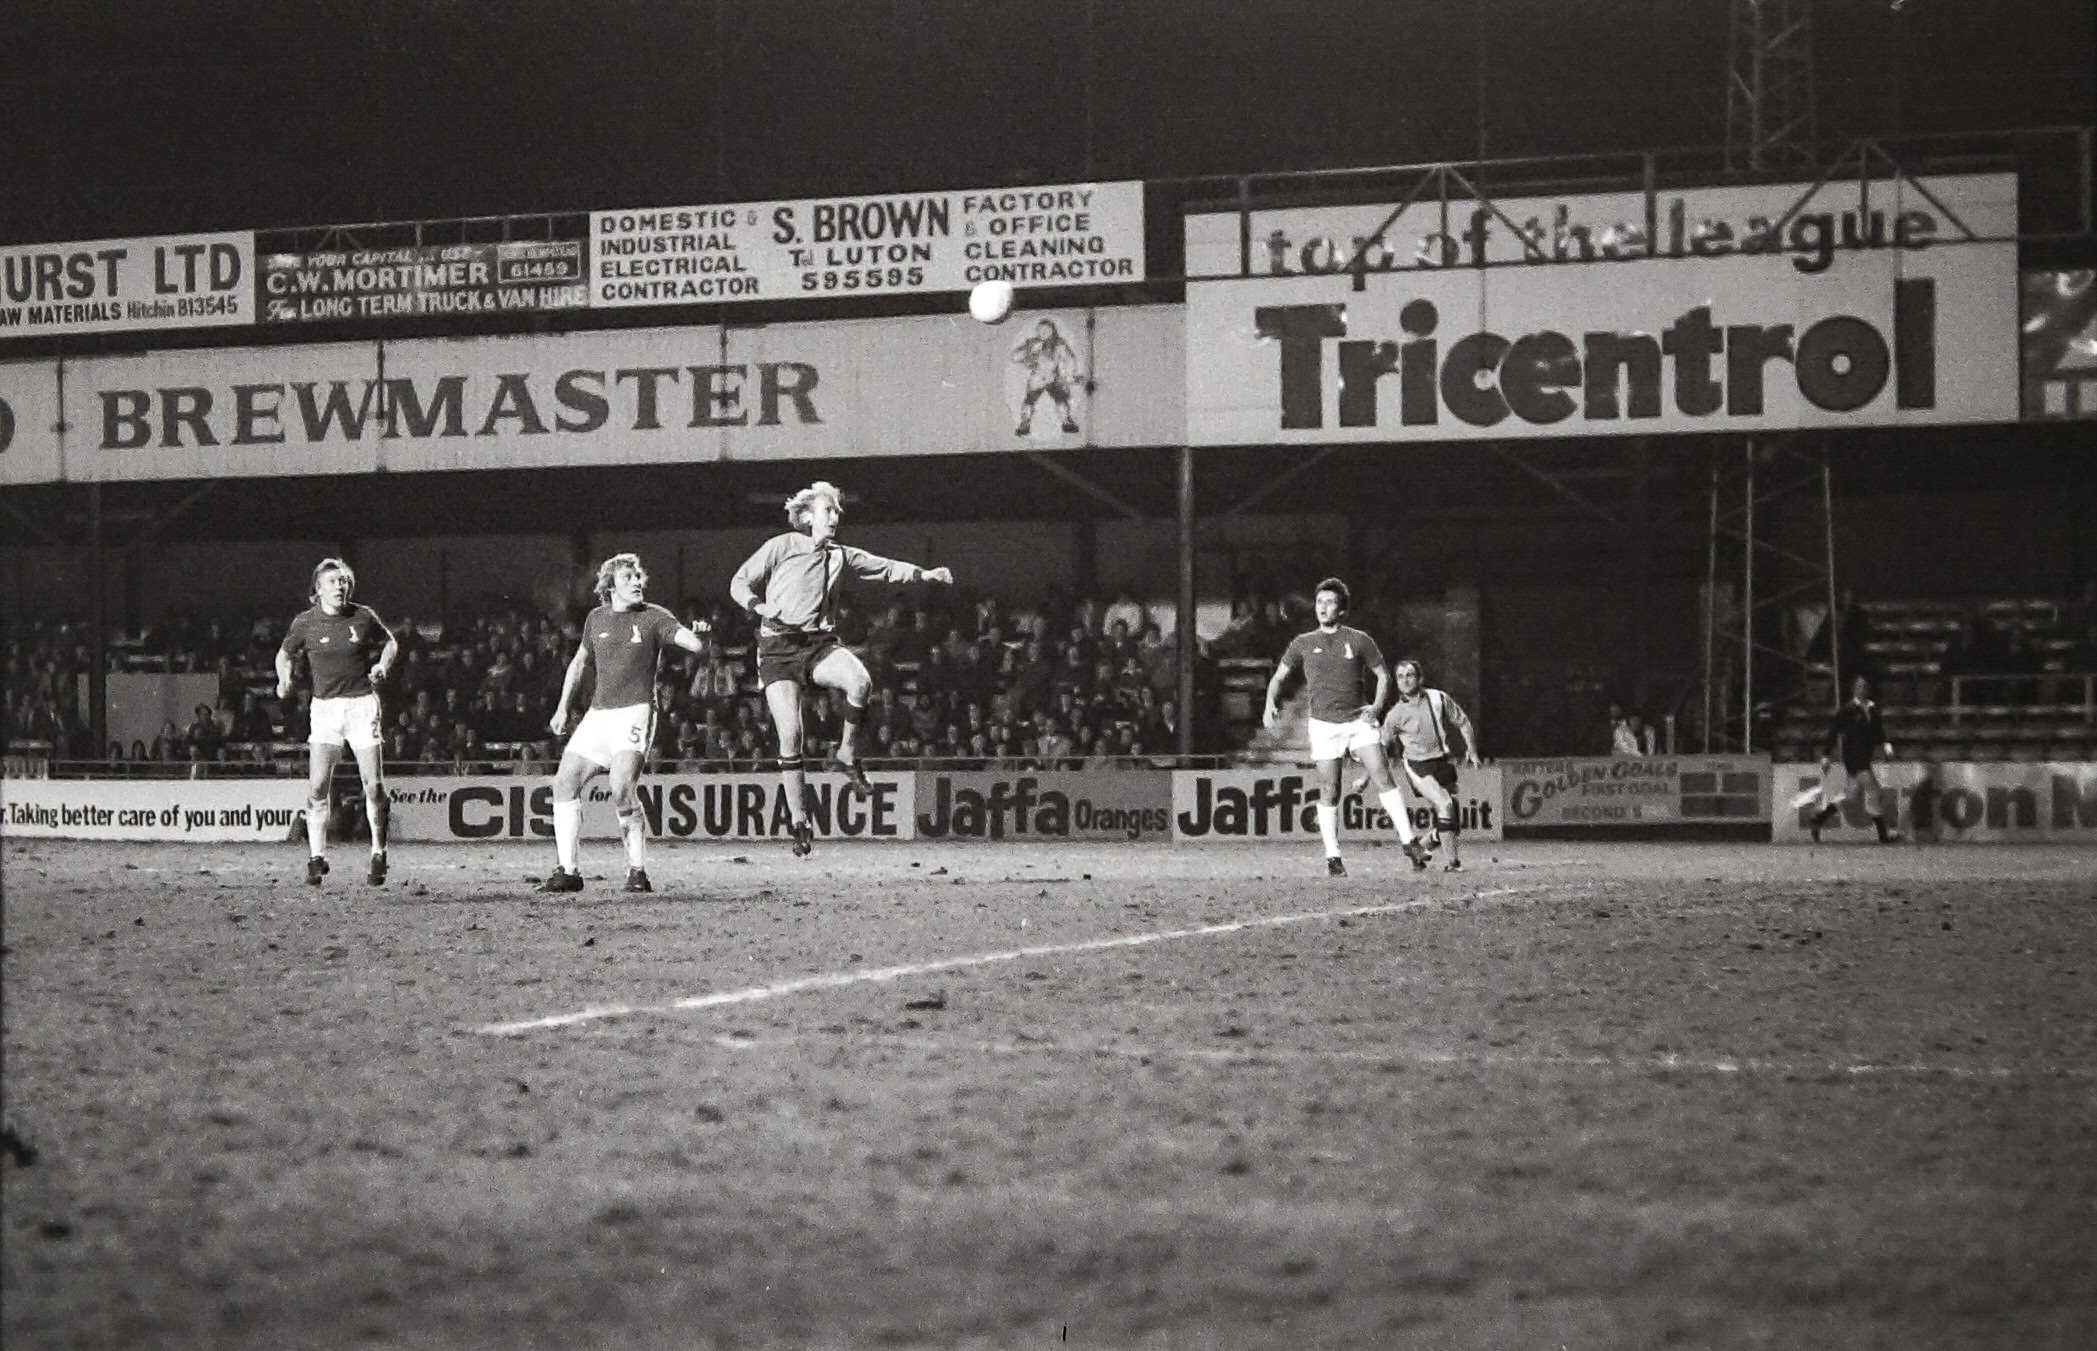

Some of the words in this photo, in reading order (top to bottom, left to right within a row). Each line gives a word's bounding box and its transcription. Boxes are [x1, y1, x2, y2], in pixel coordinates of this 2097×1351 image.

[963, 190, 1094, 213] FACTORY
[600, 210, 737, 233] DOMESTIC
[772, 206, 802, 244] S.
[814, 198, 950, 242] BROWN
[988, 213, 1091, 236] OFFICE
[600, 232, 737, 256] INDUSTRIAL
[826, 242, 932, 267] LUTON
[964, 235, 1105, 259] CLEANING
[1266, 228, 1394, 291] top
[1416, 207, 1492, 269] of
[1520, 203, 1648, 262] the
[1668, 197, 1939, 273] league
[5, 248, 128, 303] URST
[154, 243, 241, 294] LTD
[600, 255, 748, 278] ELECTRICAL
[801, 266, 924, 291] 595595
[965, 258, 1134, 283] CONTRACTOR
[601, 277, 760, 301] CONTRACTOR
[28, 302, 122, 325] MATERIALS
[300, 295, 353, 321] LONG
[358, 291, 412, 315] TERM
[417, 289, 481, 315] TRUCK
[497, 287, 535, 308] VAN
[1255, 277, 1937, 429] Tricentrol
[97, 361, 824, 450] BREWMASTER
[628, 725, 642, 743] 5
[8, 803, 58, 828] Taking
[62, 803, 114, 826] better
[118, 809, 157, 826] care
[160, 804, 180, 827] of
[184, 809, 215, 832] you
[219, 804, 251, 827] and
[256, 809, 293, 832] your
[389, 787, 418, 804] See
[419, 787, 447, 804] the
[448, 784, 557, 838] CIS
[588, 785, 613, 802] for
[636, 783, 899, 838] NSURANCE
[916, 777, 1070, 839] Jaffa
[1074, 798, 1169, 840] Oranges
[1177, 775, 1321, 836] Jaffa
[1343, 793, 1493, 832] Graeuit
